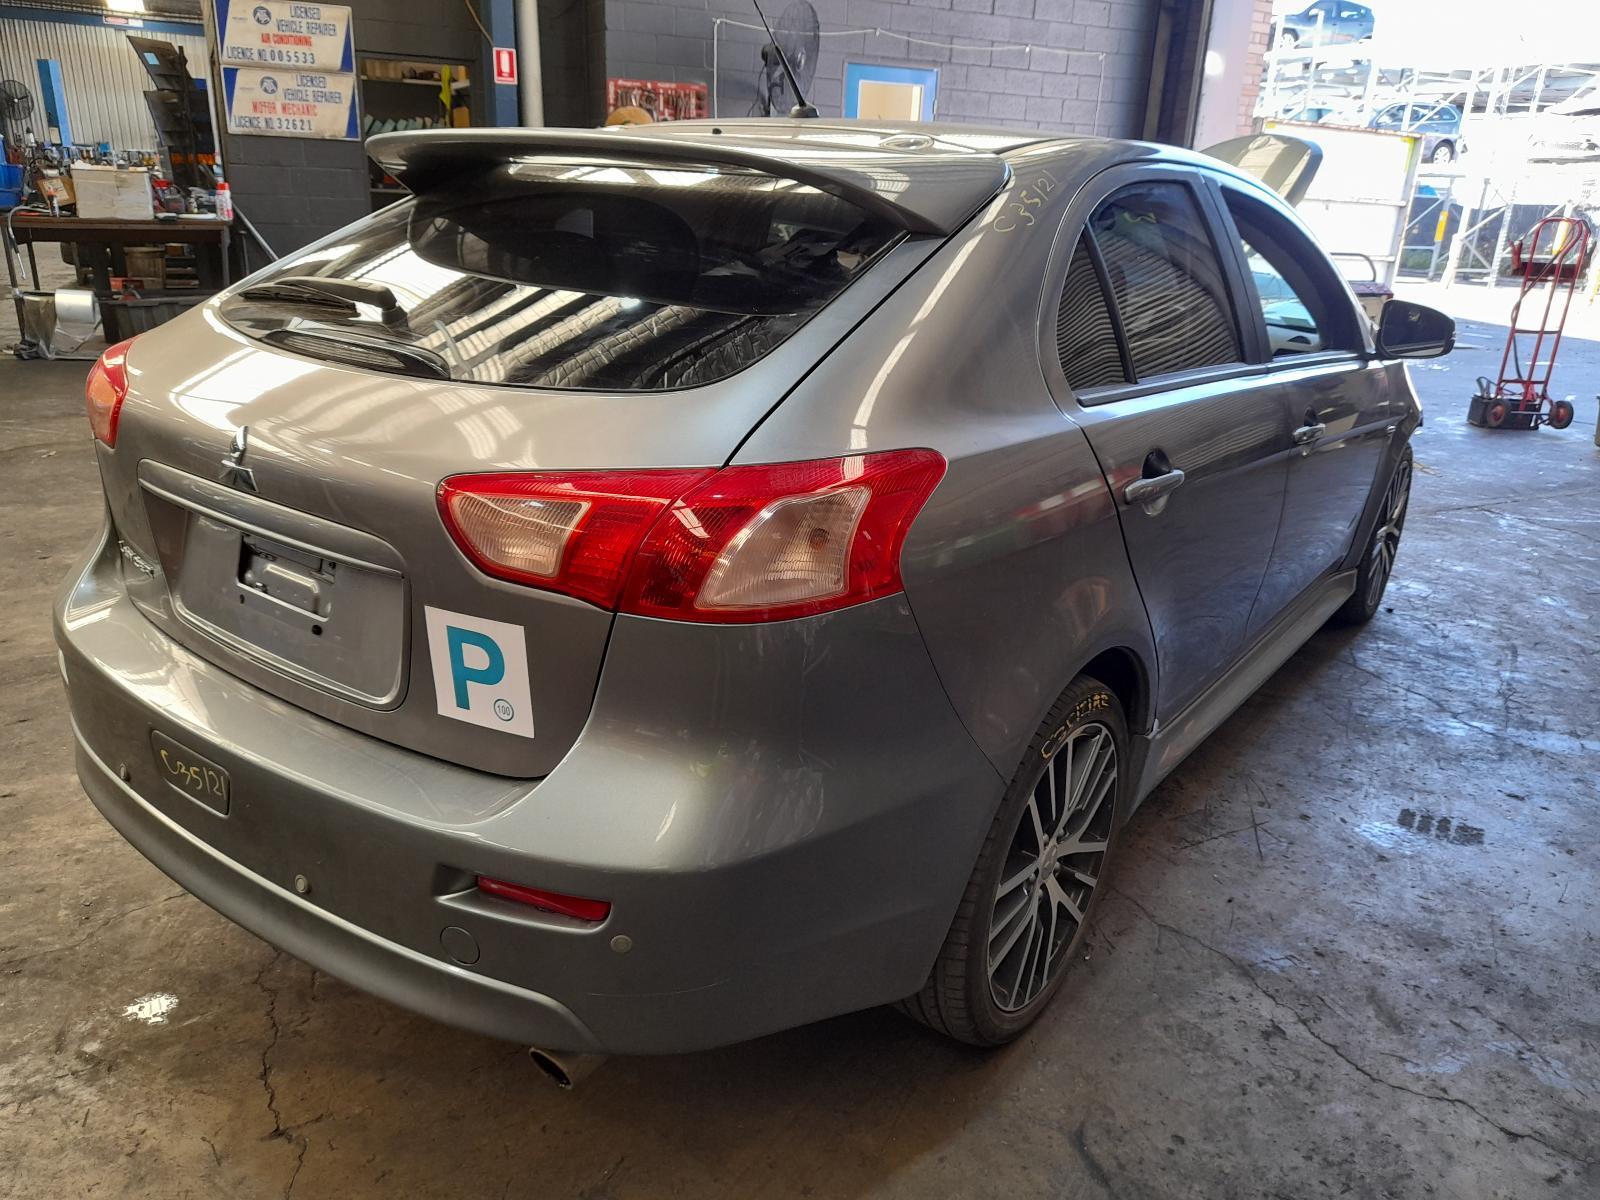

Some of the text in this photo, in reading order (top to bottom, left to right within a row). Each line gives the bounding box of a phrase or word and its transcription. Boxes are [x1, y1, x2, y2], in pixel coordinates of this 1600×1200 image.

[289, 5, 321, 20] LICENSED
[276, 19, 337, 36] VEHICLE REPAIRER
[261, 33, 312, 47] AIR CONDITIONING
[226, 46, 254, 60] LICENCE
[270, 49, 315, 65] 005533
[296, 74, 327, 89] LICENSED
[283, 88, 342, 104] VEHICLE REPAIRER
[251, 101, 318, 116] MOTOR MECHANIC
[233, 115, 262, 129] LICENCE
[276, 117, 313, 131] 32621
[993, 169, 1058, 232] C35121
[446, 625, 505, 710] P
[497, 704, 511, 717] 100
[160, 749, 227, 801] C35121
